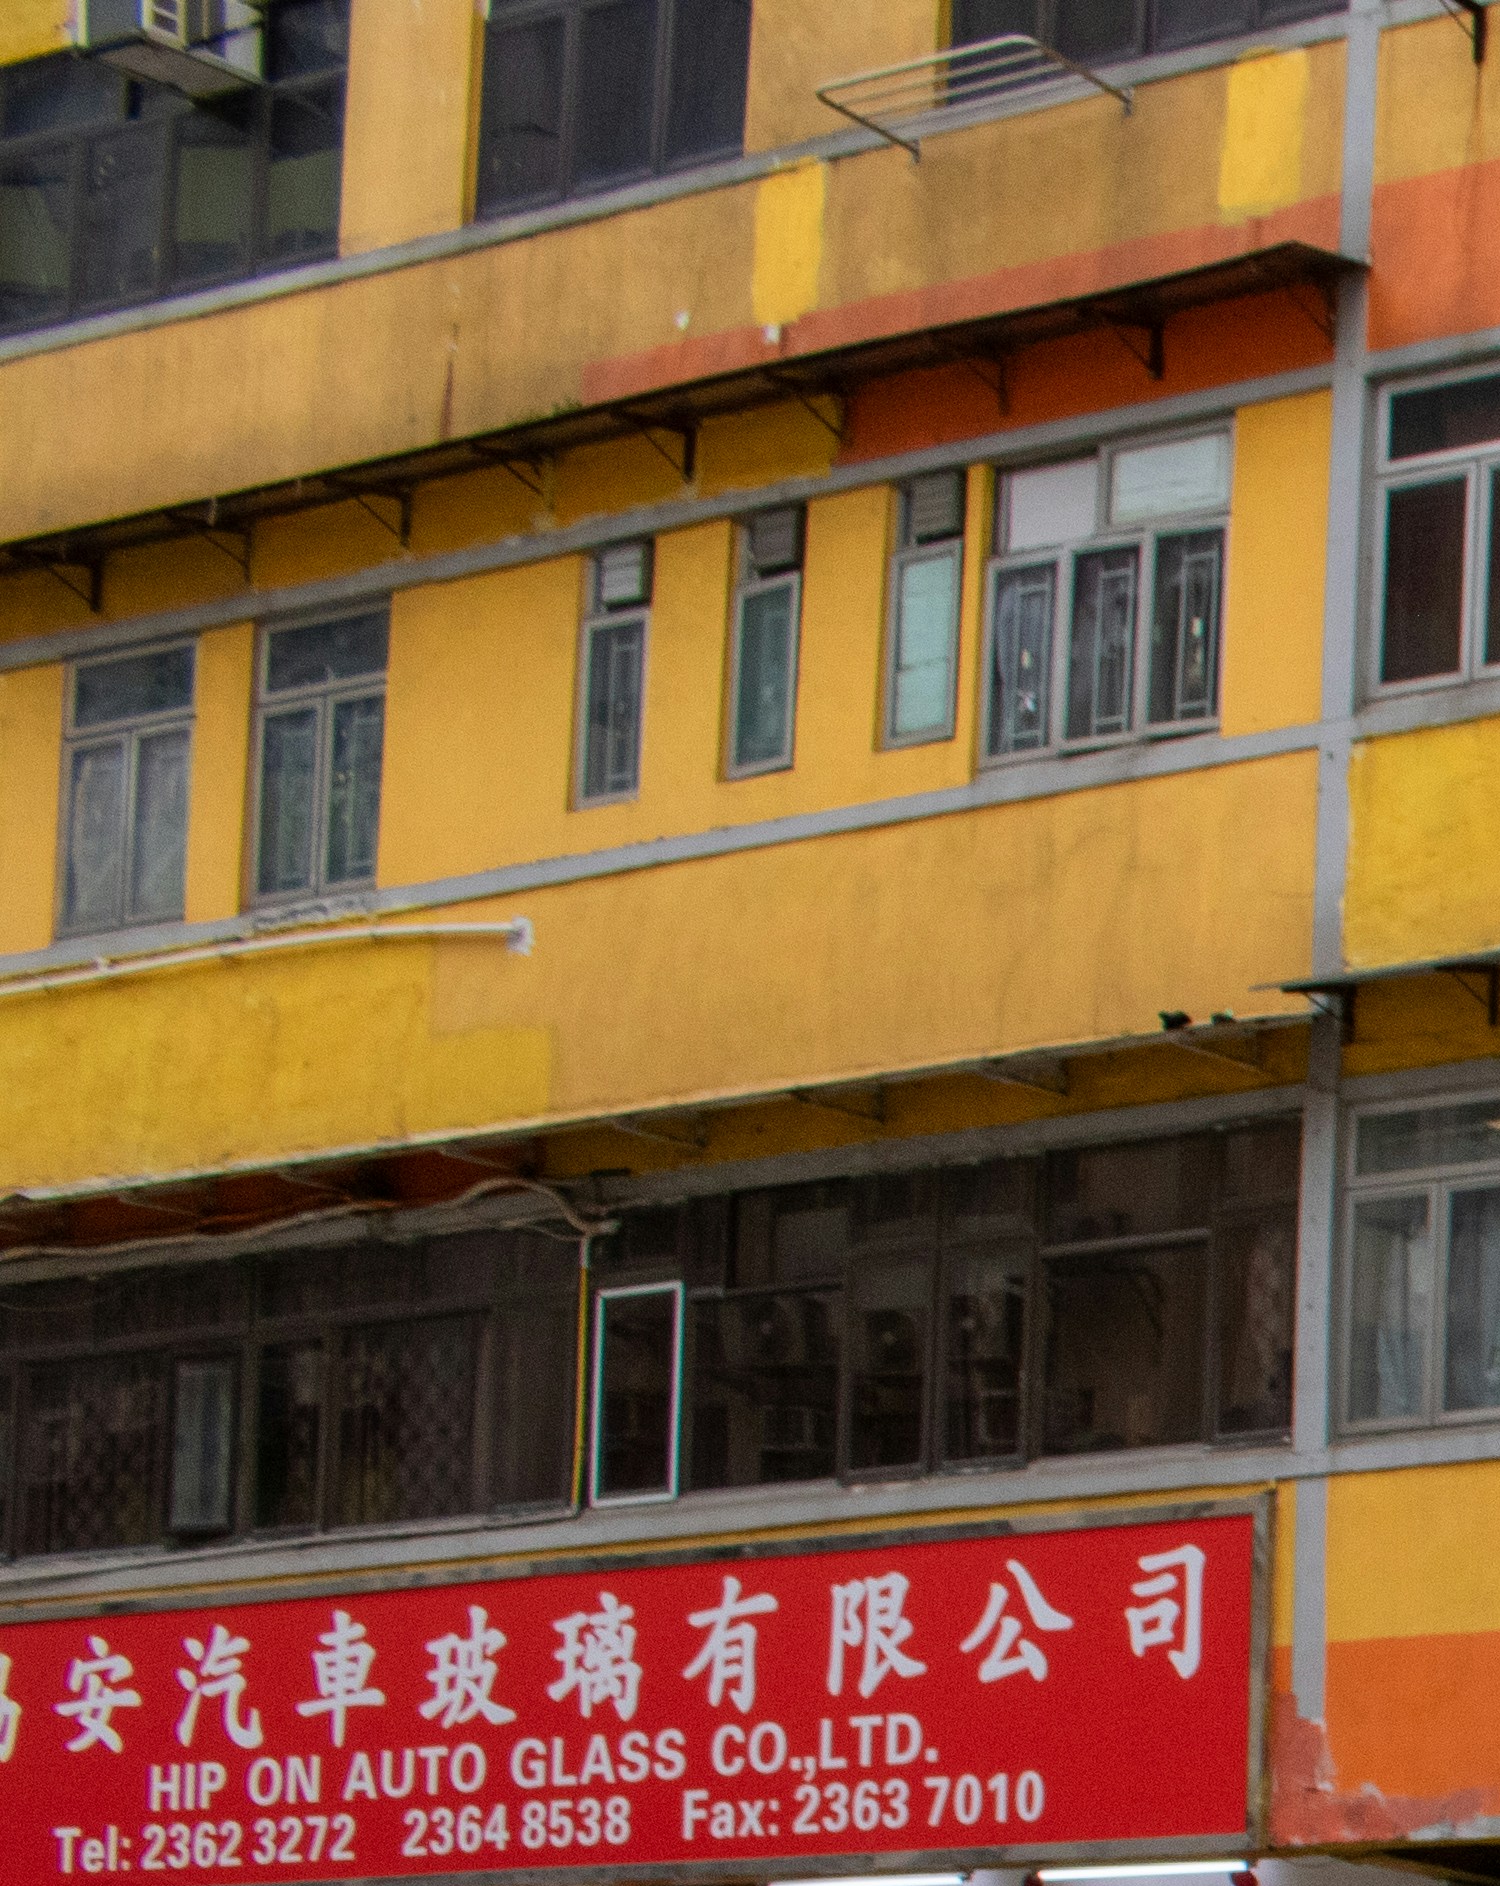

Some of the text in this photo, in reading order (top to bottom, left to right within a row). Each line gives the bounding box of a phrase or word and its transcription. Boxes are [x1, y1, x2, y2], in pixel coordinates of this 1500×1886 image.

[149, 1763, 226, 1811] HIP
[247, 1756, 321, 1805] ON
[343, 1743, 486, 1800] AUTO
[509, 1729, 686, 1789] GLASS
[55, 1769, 1046, 1873] Tel: 2362 3272 2364 8538 Fax: 2363 7010
